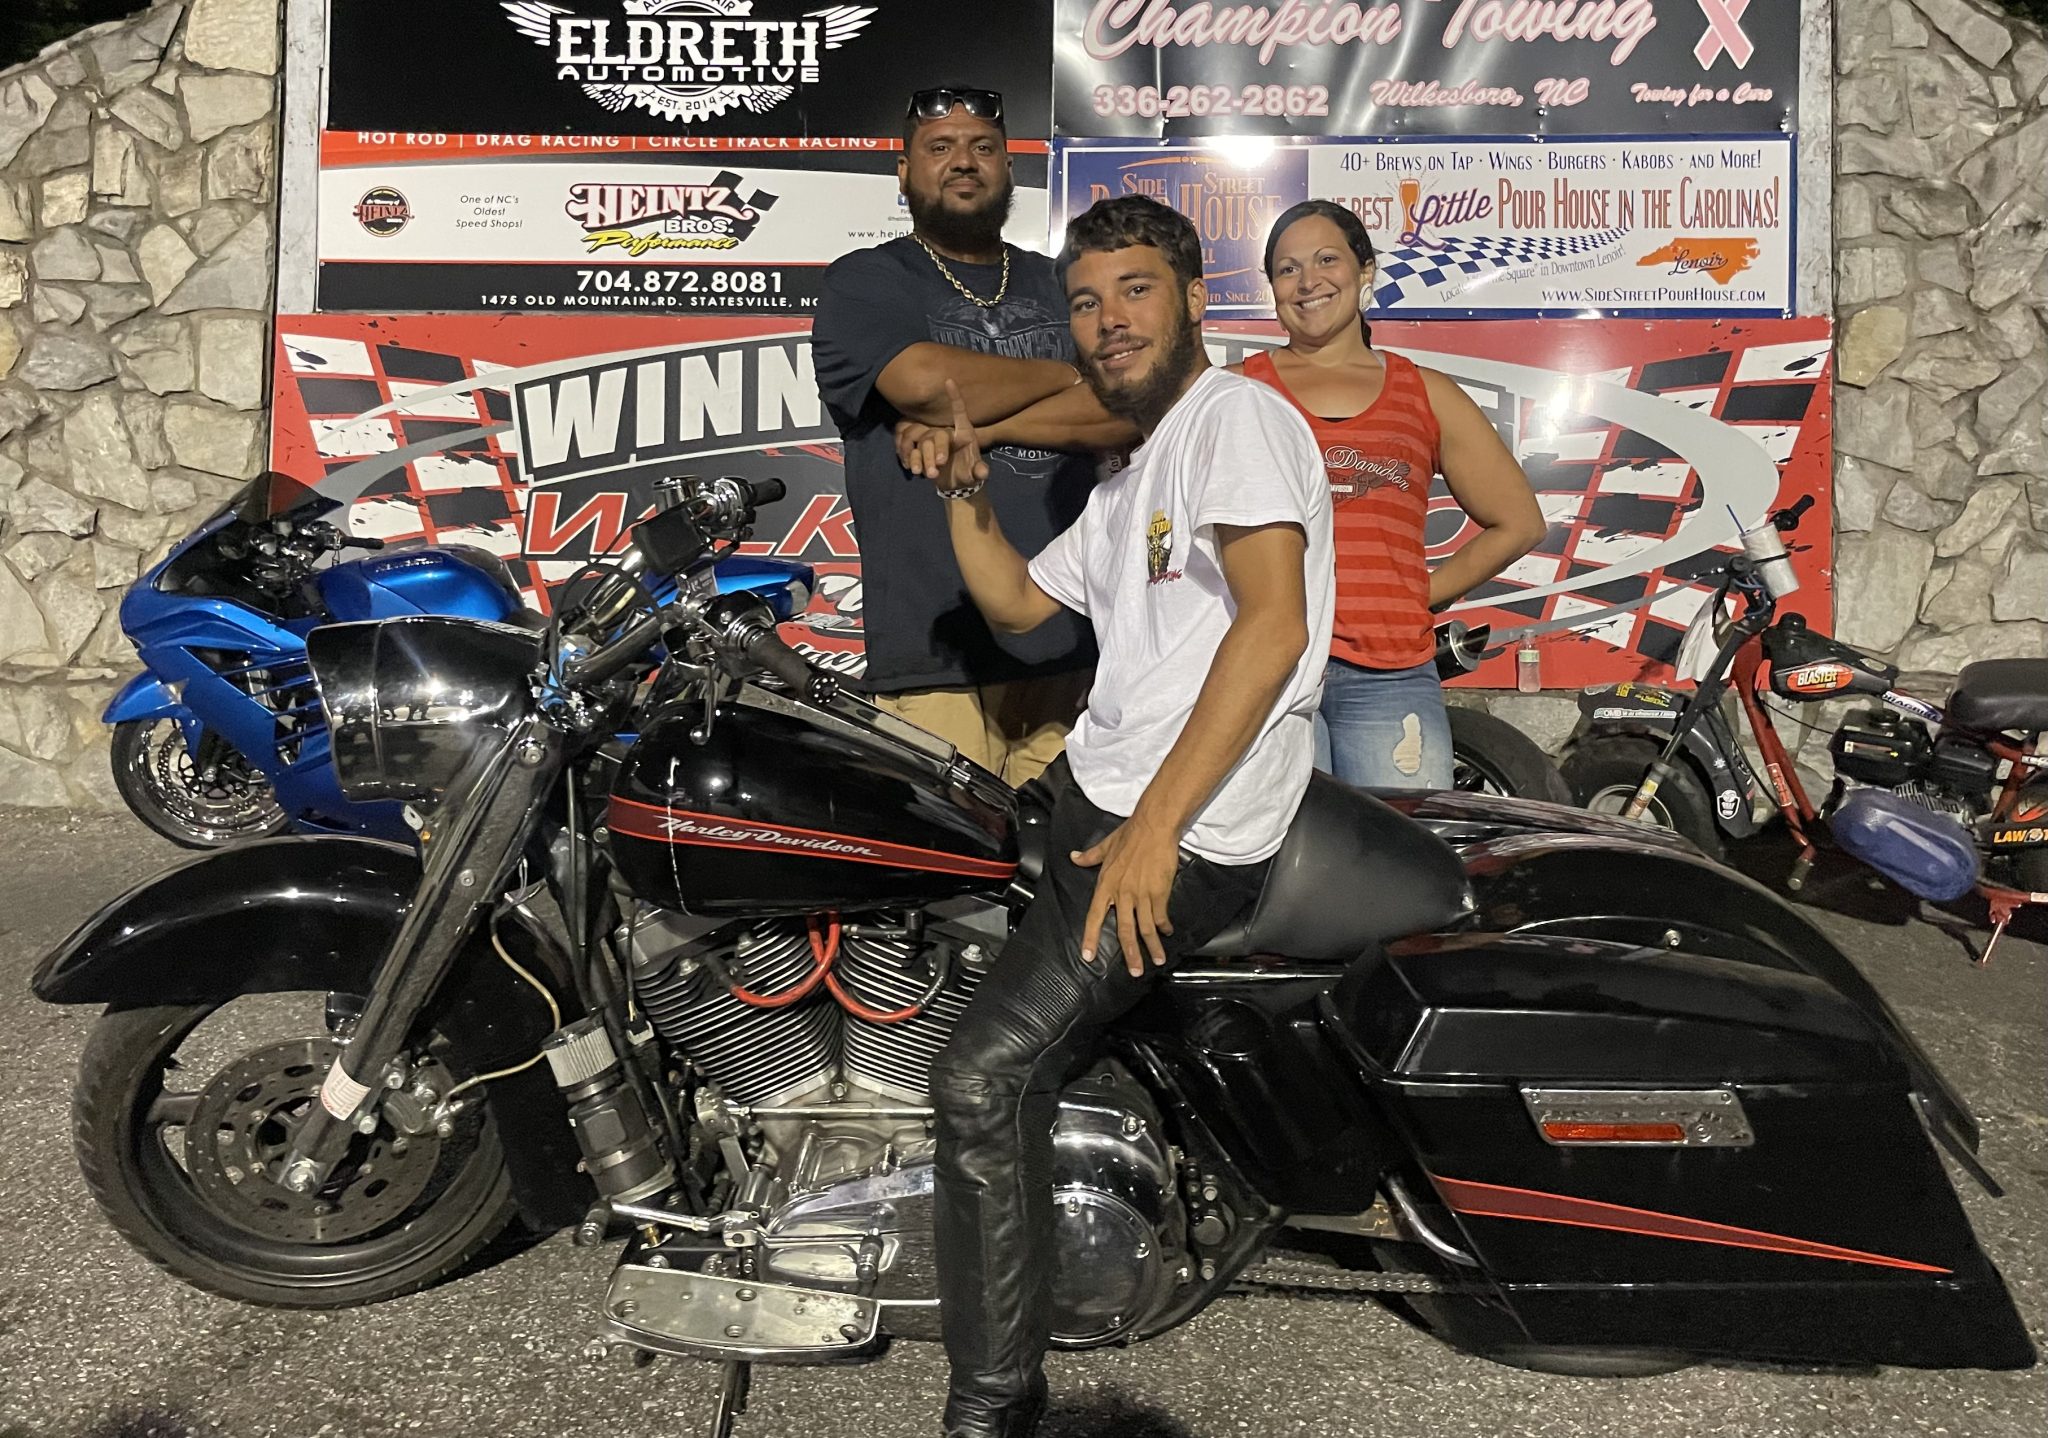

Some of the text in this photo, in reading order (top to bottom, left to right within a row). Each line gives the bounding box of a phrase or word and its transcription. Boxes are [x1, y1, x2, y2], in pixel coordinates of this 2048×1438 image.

[556, 19, 820, 66] ELDRETH
[1083, 0, 1656, 65] Champion Towing
[557, 65, 820, 83] AUTOMOTIVE
[657, 96, 717, 111] EST. 2014
[1093, 84, 1329, 117] 336-262-2862
[1370, 77, 1590, 107] Wilkesboro, NC
[1630, 82, 1687, 107] Towing
[1688, 83, 1714, 107] for
[1715, 88, 1730, 101] a
[358, 132, 877, 148] HOT ROD DRAG RACING CIRCLE TRACK RACING
[1340, 152, 1370, 171] 40+
[460, 195, 519, 204] One of NC's
[565, 183, 757, 230] HEINTZ
[473, 207, 506, 216] Oldest
[1400, 188, 1493, 250] Little
[456, 219, 523, 229] Speed Shops!
[664, 219, 735, 233] BROS.
[848, 229, 910, 238] www.heint
[581, 230, 739, 257] Performance
[1540, 262, 1549, 276] in
[1551, 257, 1595, 276] Downtown
[1596, 243, 1626, 267] Lenoir!
[1668, 249, 1728, 275] Lenoir
[577, 270, 782, 292] 704.872.8081
[481, 295, 517, 305] 1475
[525, 295, 556, 305] OLD
[563, 295, 650, 306] MOUNTAIN
[657, 296, 682, 306] RD.
[690, 296, 793, 307] STATESVILLE,
[524, 342, 821, 468] WINN
[1325, 445, 1409, 492] Davidson
[1797, 670, 1837, 686] BLASTER
